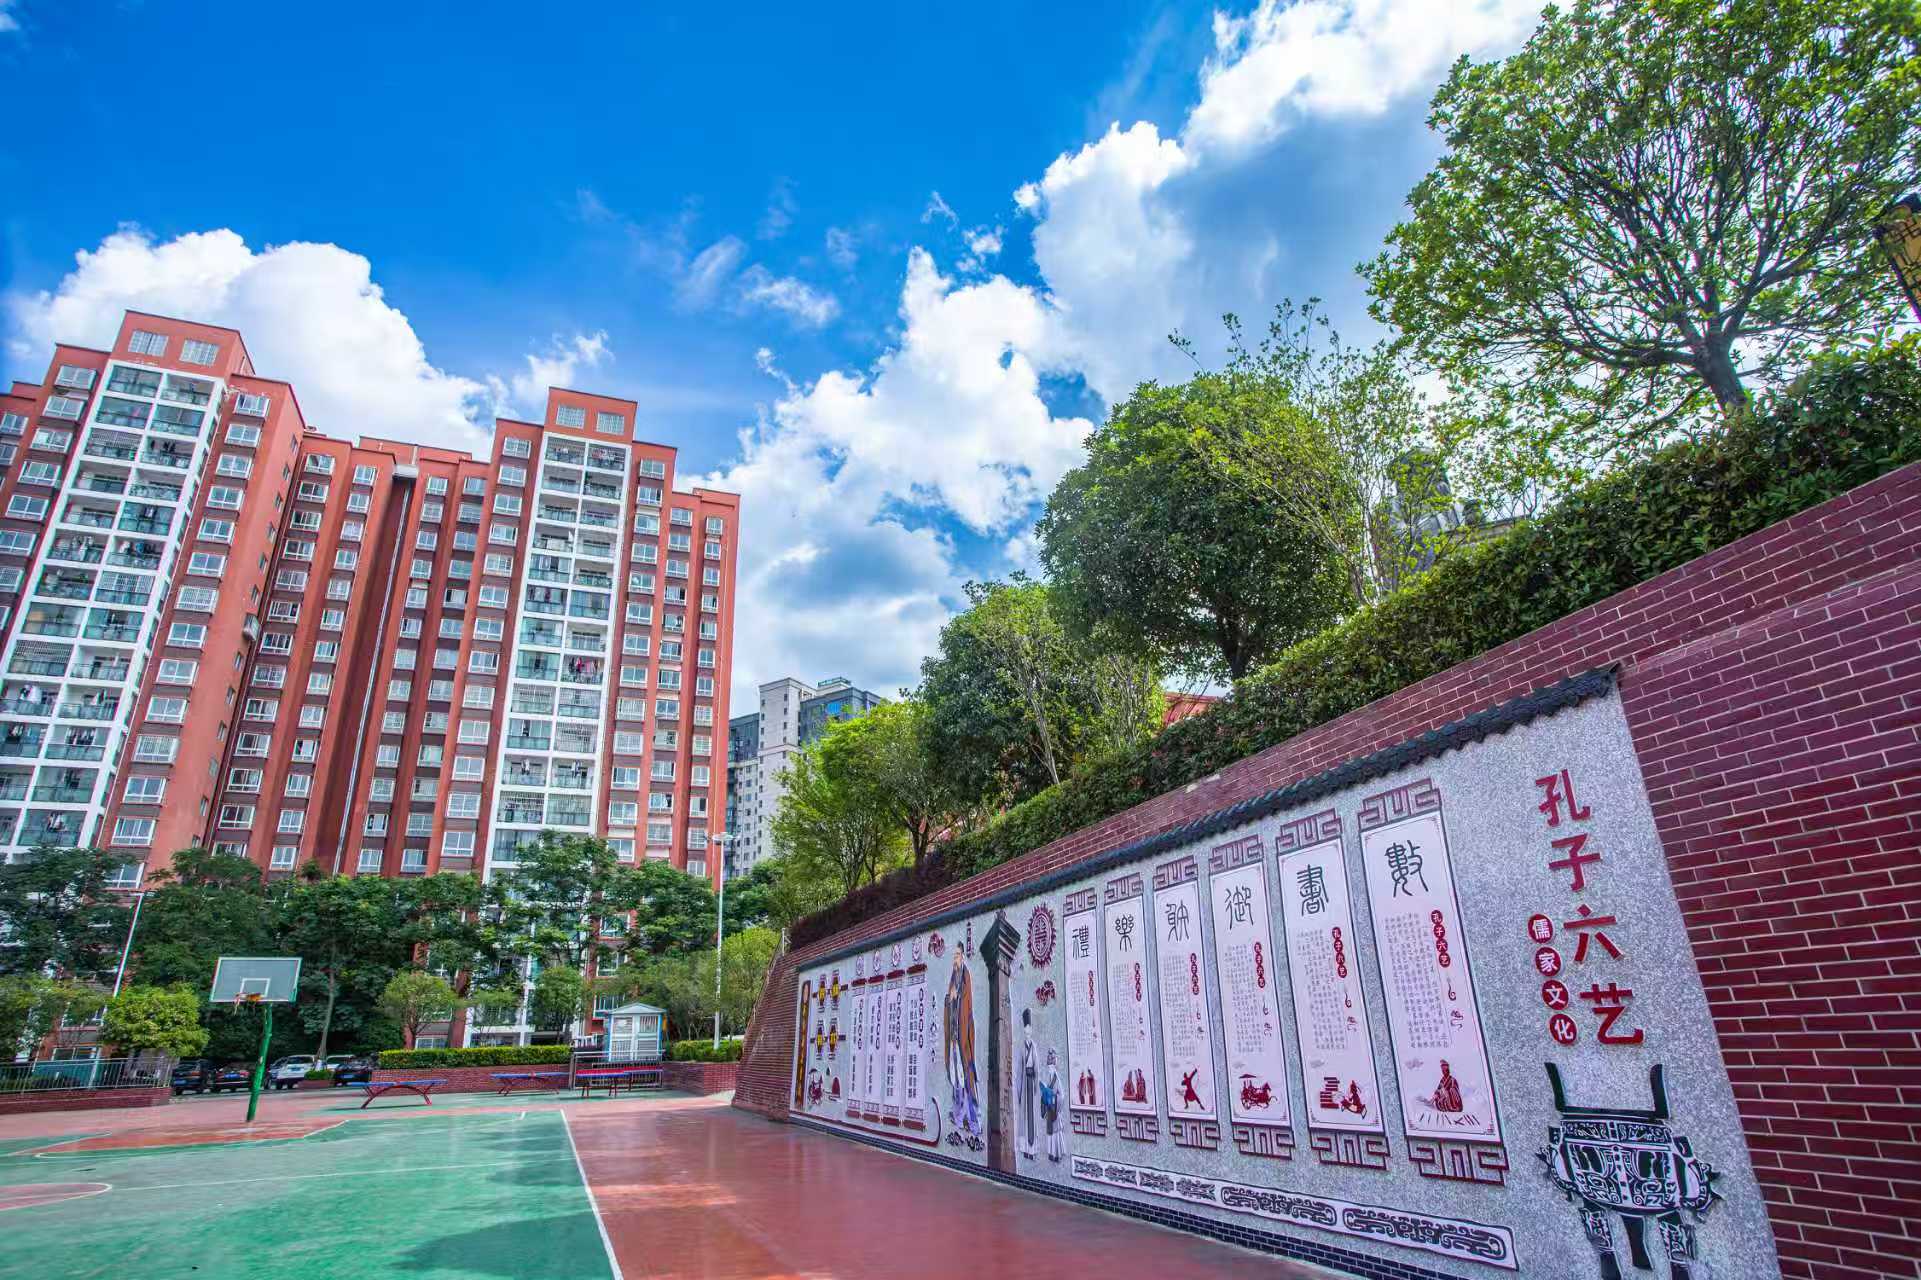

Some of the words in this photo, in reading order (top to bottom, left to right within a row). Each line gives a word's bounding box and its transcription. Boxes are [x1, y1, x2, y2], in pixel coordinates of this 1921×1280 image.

[1431, 910, 1450, 967] 孔子六艺
[1535, 768, 1644, 1046] 孔子六艺
[1530, 915, 1576, 1044] 儒家文化
